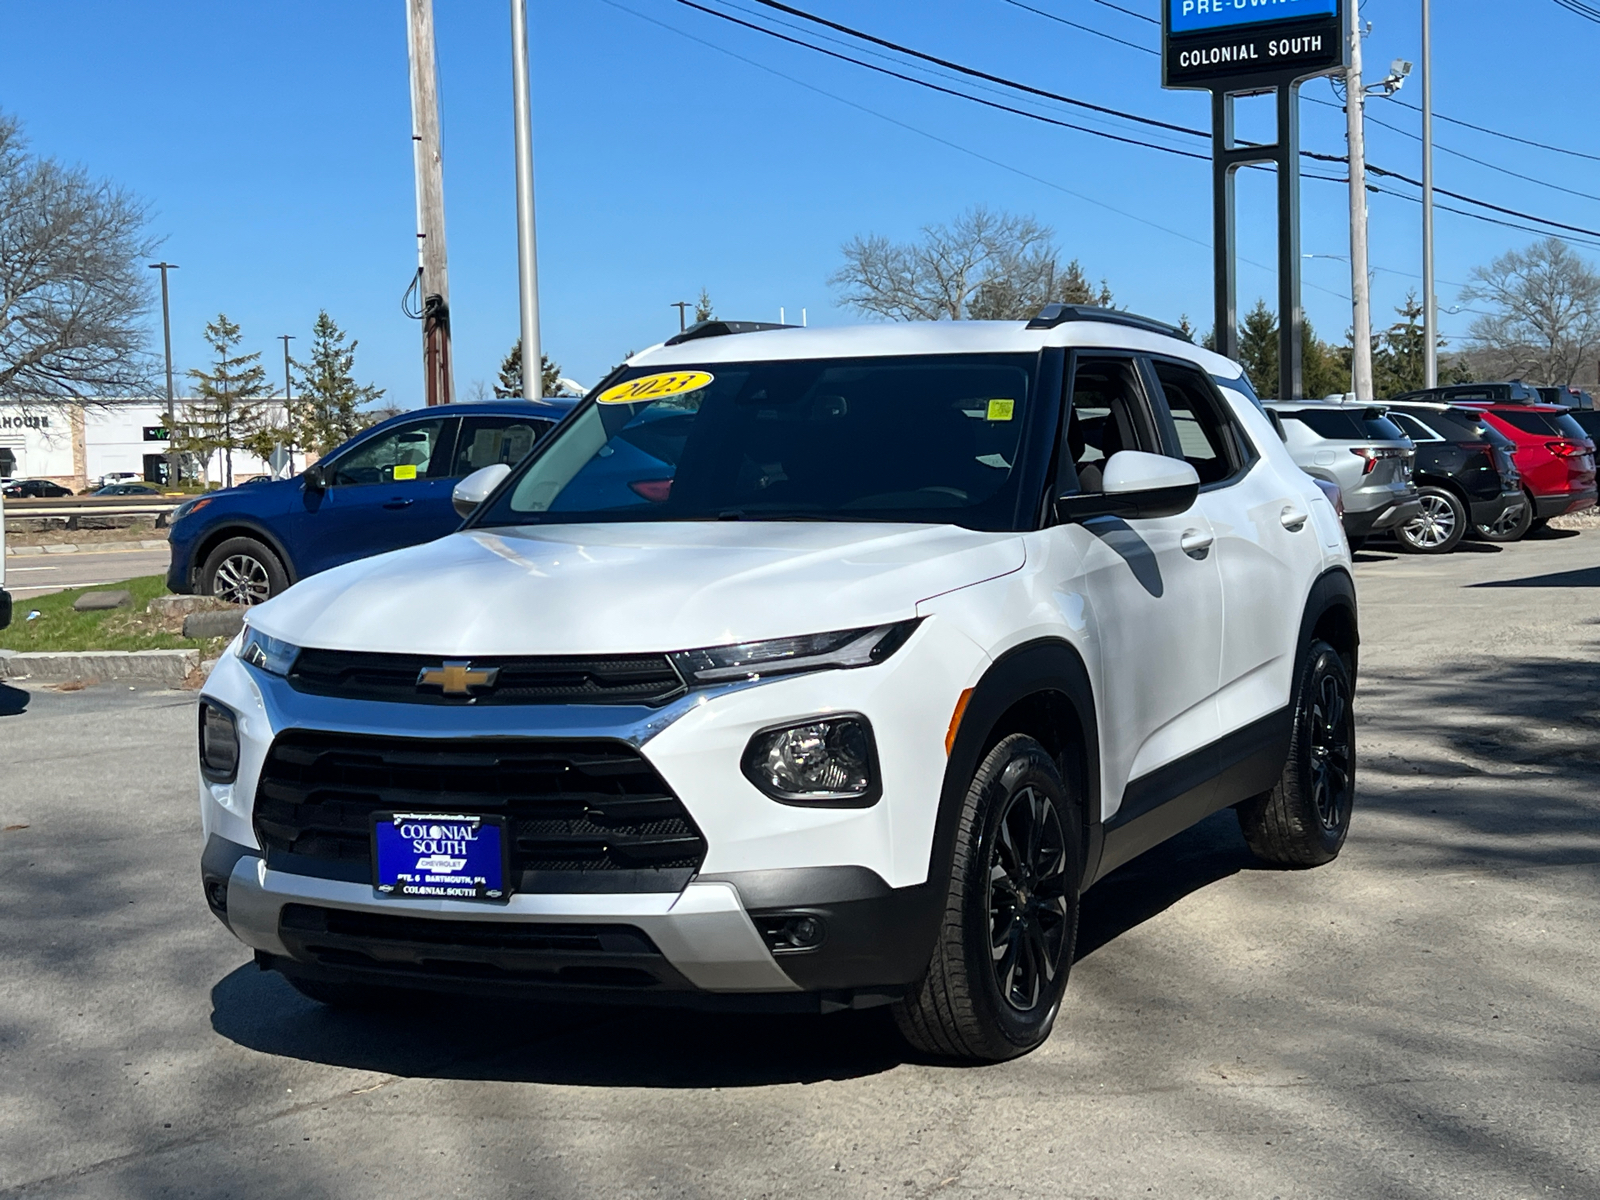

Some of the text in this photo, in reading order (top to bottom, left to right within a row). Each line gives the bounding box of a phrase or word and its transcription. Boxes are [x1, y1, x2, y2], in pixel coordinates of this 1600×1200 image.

[1180, 35, 1322, 67] COLONIAL SOUTH
[610, 374, 696, 400] 2023
[0, 416, 49, 429] HOUSE
[400, 824, 478, 841] COLONIAL
[413, 839, 467, 855] SOUTH
[420, 860, 462, 868] CHEVROLET
[403, 885, 476, 897] COLONIAL SOUTH
